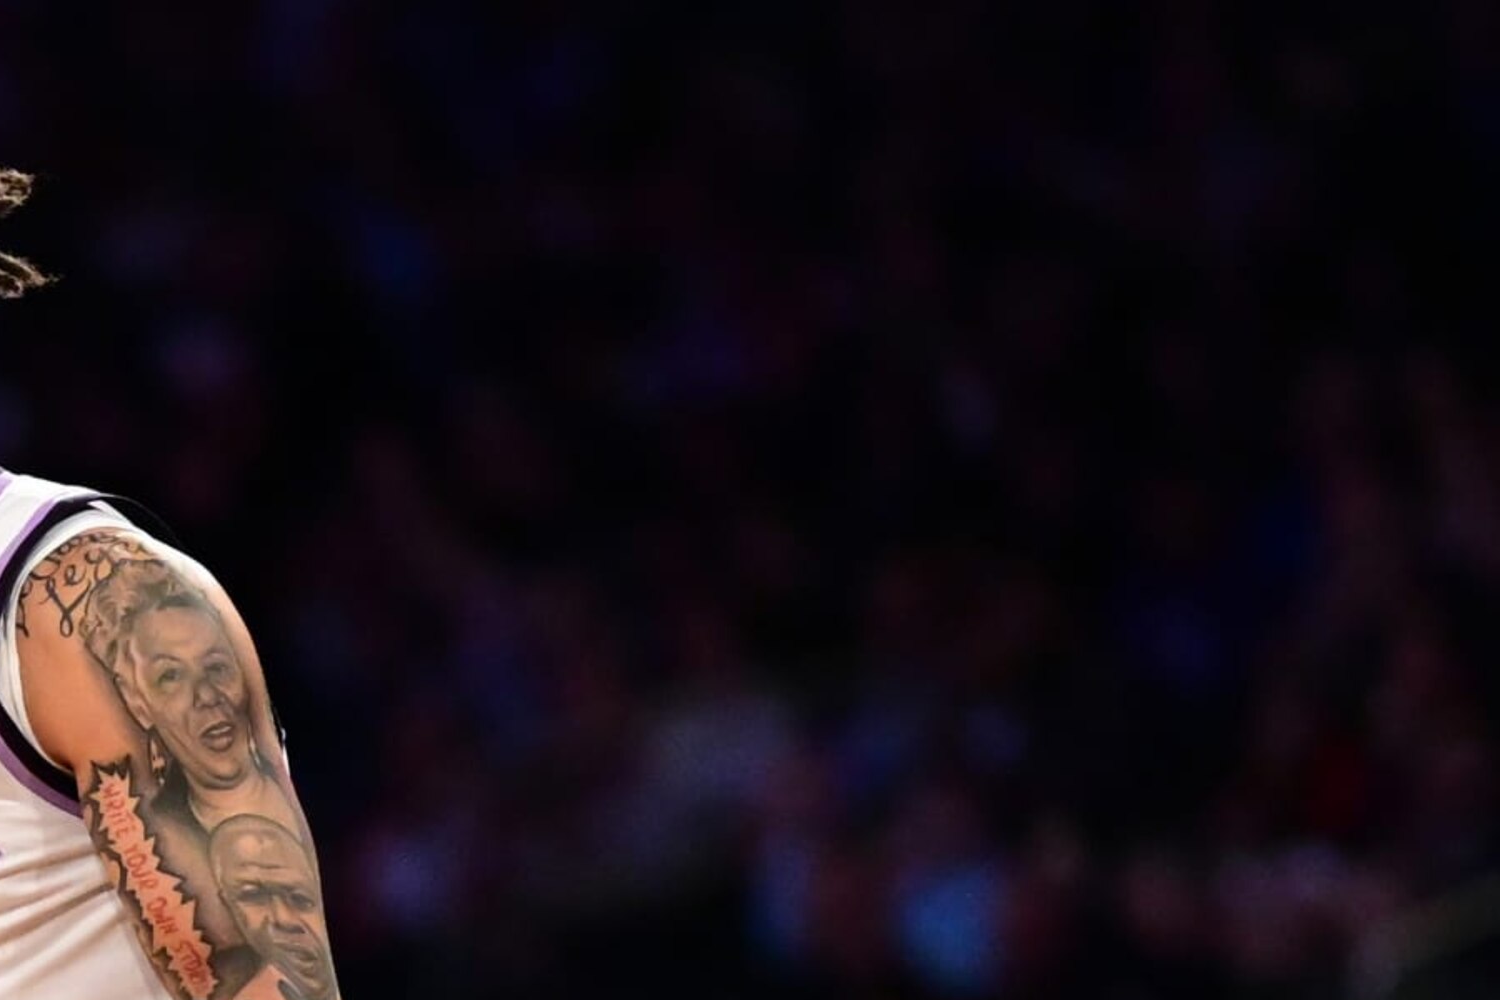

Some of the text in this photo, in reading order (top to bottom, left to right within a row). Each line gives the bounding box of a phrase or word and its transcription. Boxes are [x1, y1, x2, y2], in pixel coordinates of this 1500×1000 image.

[102, 781, 138, 840] WRITE
[124, 842, 160, 891] YOUR
[146, 896, 179, 936] OWN
